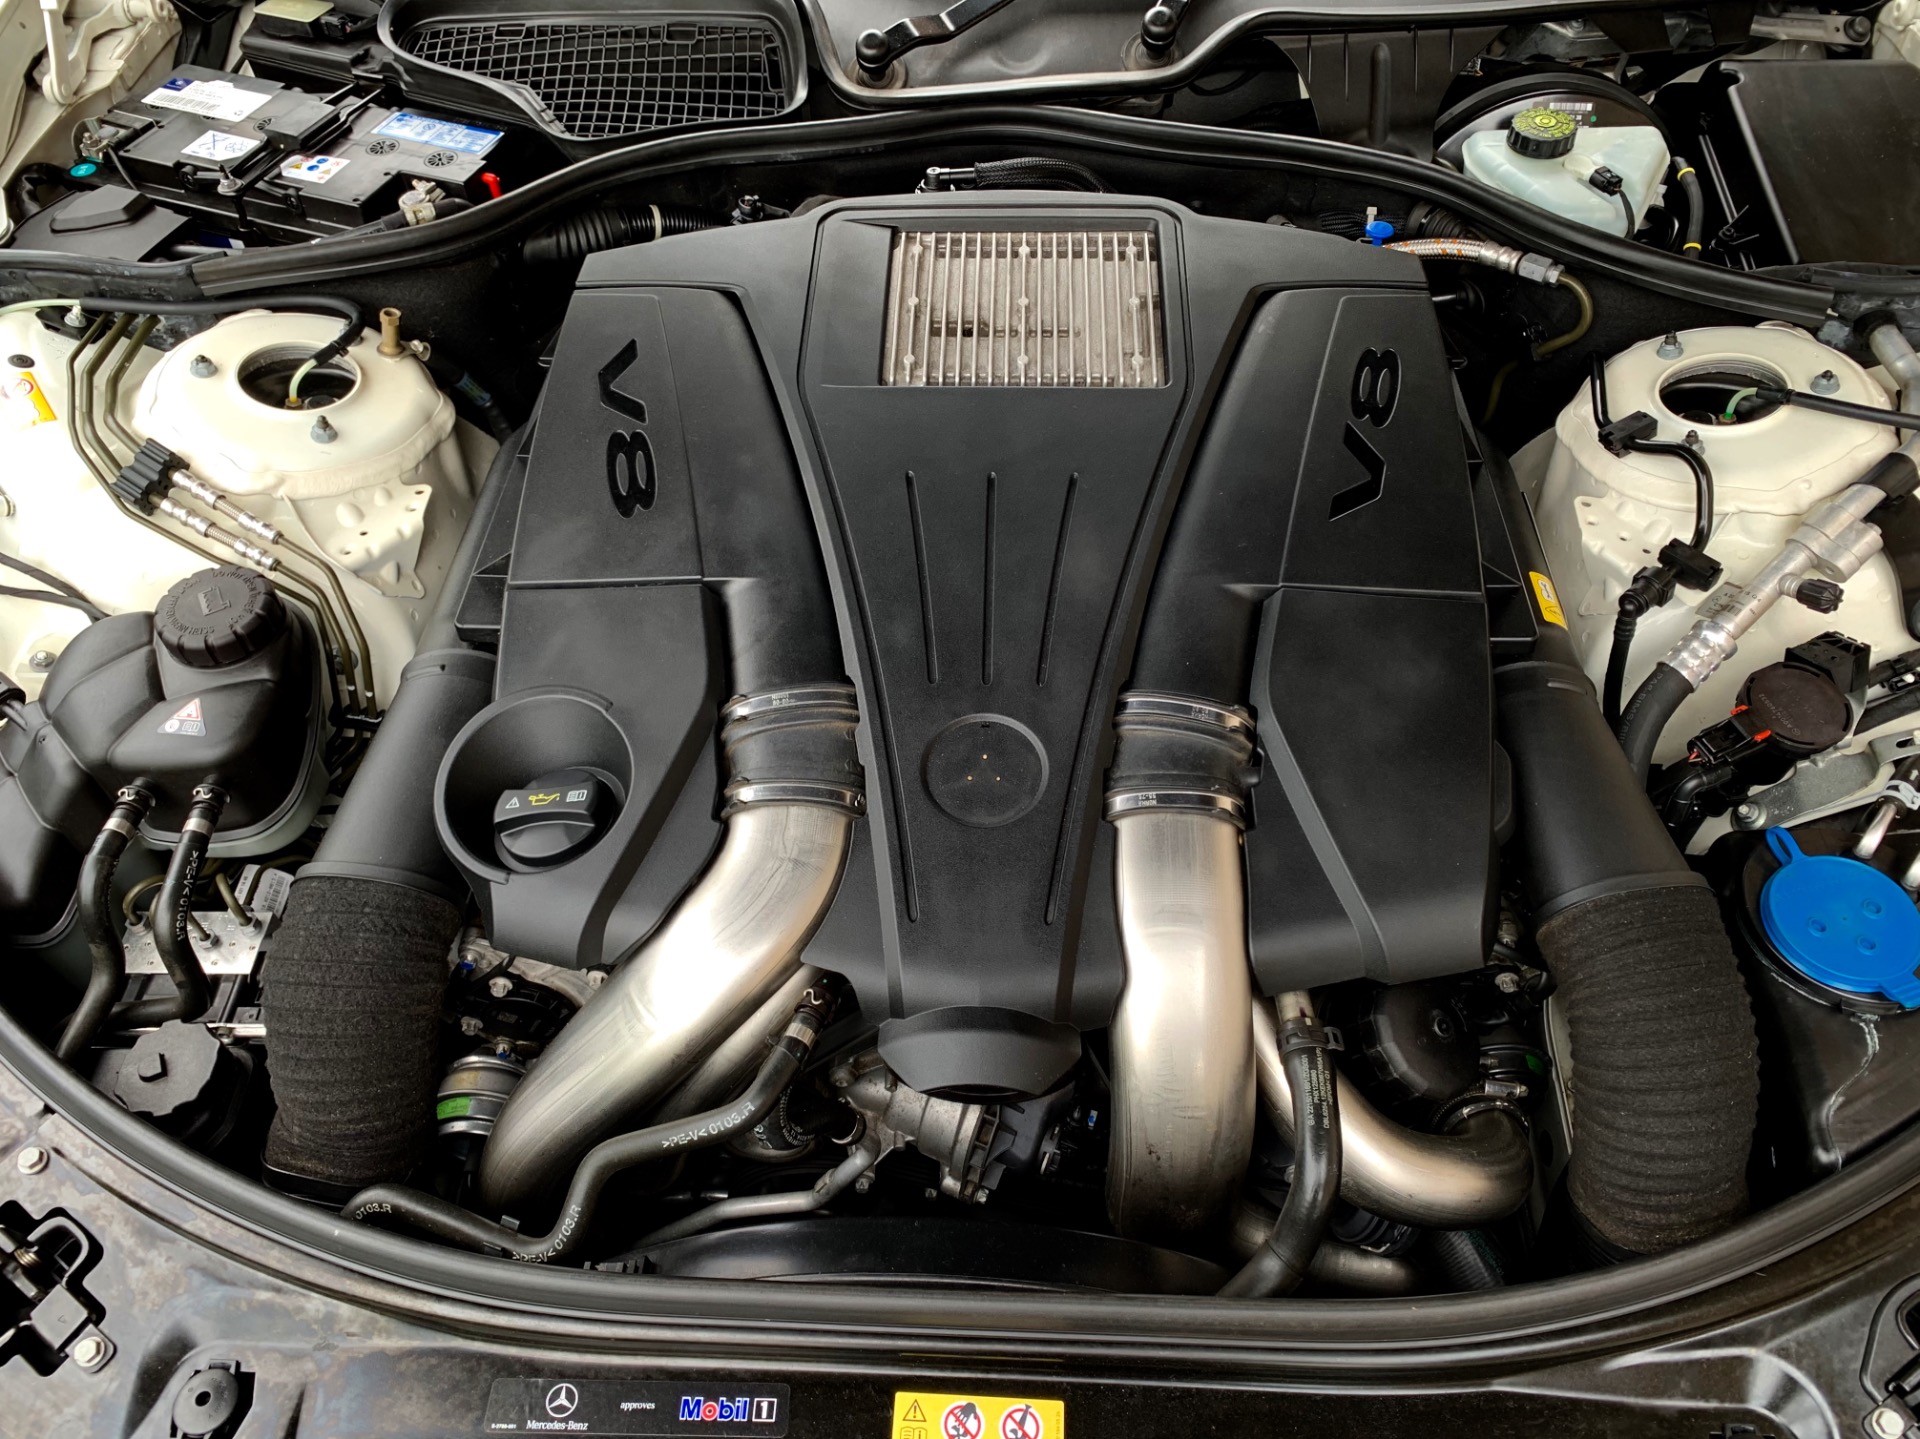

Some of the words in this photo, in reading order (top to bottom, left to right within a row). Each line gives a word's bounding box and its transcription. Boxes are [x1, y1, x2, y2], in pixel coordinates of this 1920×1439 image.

[598, 338, 657, 519] V8
[1328, 346, 1401, 522] V8
[708, 1101, 756, 1135] 0103.R
[355, 1203, 392, 1220] 0103.R
[554, 1204, 582, 1250] 0103.R
[526, 1420, 589, 1430] Mercedes-Benz
[620, 1400, 655, 1410] approves
[679, 1396, 750, 1422] Mobil
